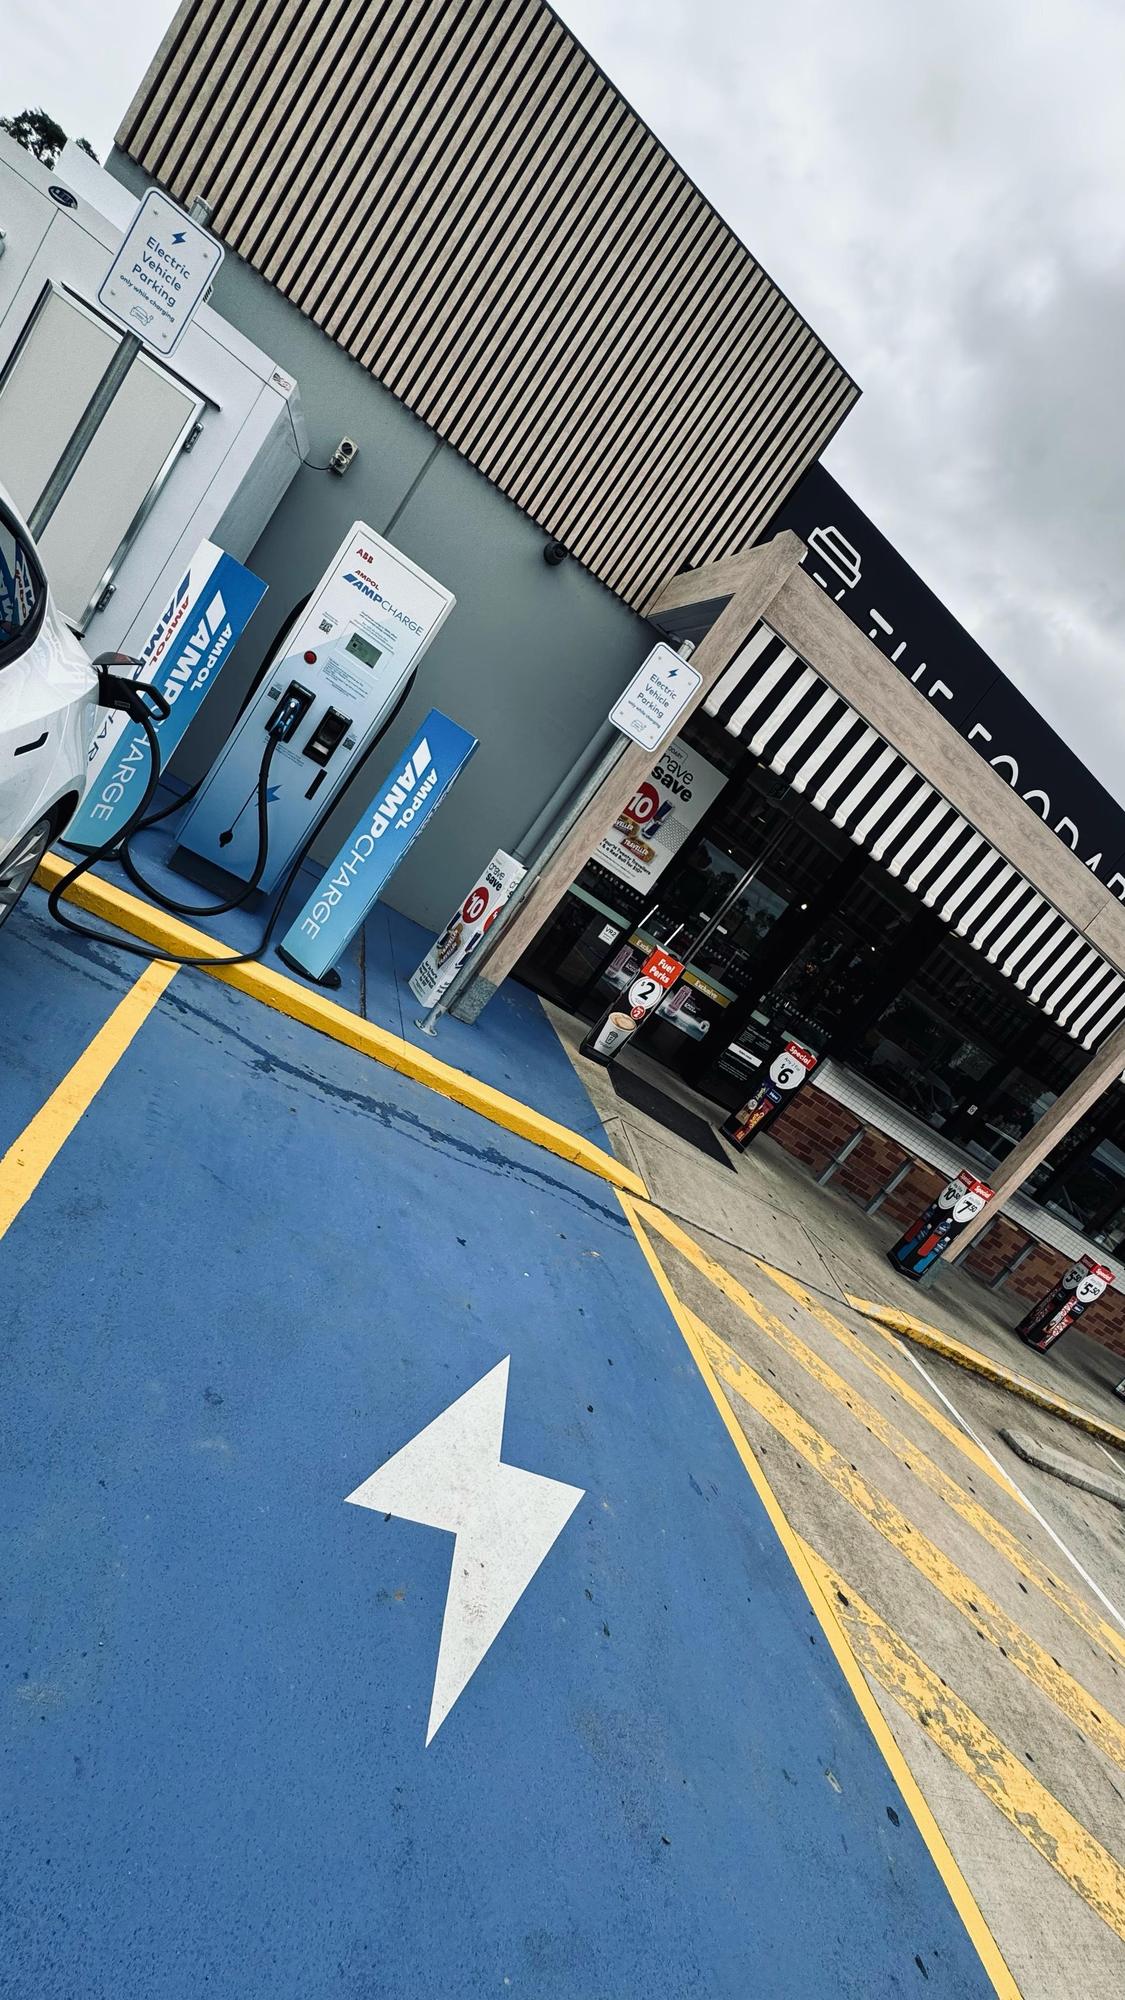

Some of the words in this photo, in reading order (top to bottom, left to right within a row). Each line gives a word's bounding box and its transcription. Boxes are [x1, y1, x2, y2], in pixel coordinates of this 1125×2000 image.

[142, 251, 182, 291] Vehicle
[146, 236, 191, 280] Electric
[132, 263, 176, 307] Parking
[120, 275, 133, 287] only
[133, 286, 149, 301] while
[150, 298, 175, 323] charging
[356, 548, 374, 564] ABB
[355, 569, 379, 590] AMPOL
[352, 580, 424, 636] AMPCHARGE
[149, 595, 189, 666] AMPOL
[190, 622, 233, 690] AMPOL
[645, 683, 670, 707] Vehicle
[650, 673, 677, 700] Electric
[637, 692, 664, 719] Parking
[90, 618, 211, 821] AMPHARGE
[659, 753, 694, 785] rave
[651, 766, 693, 802] save
[395, 768, 438, 829] AMPOL
[301, 762, 417, 940] AMPCHARGE
[486, 872, 503, 892] save
[605, 926, 617, 937] VR2
[649, 965, 671, 984] Perks
[657, 958, 676, 974] Fuel
[694, 980, 718, 999] Exclusive
[789, 1045, 812, 1065] Special
[777, 1064, 794, 1084] $6
[974, 1185, 991, 1199] Special
[1095, 1268, 1113, 1281] Special
